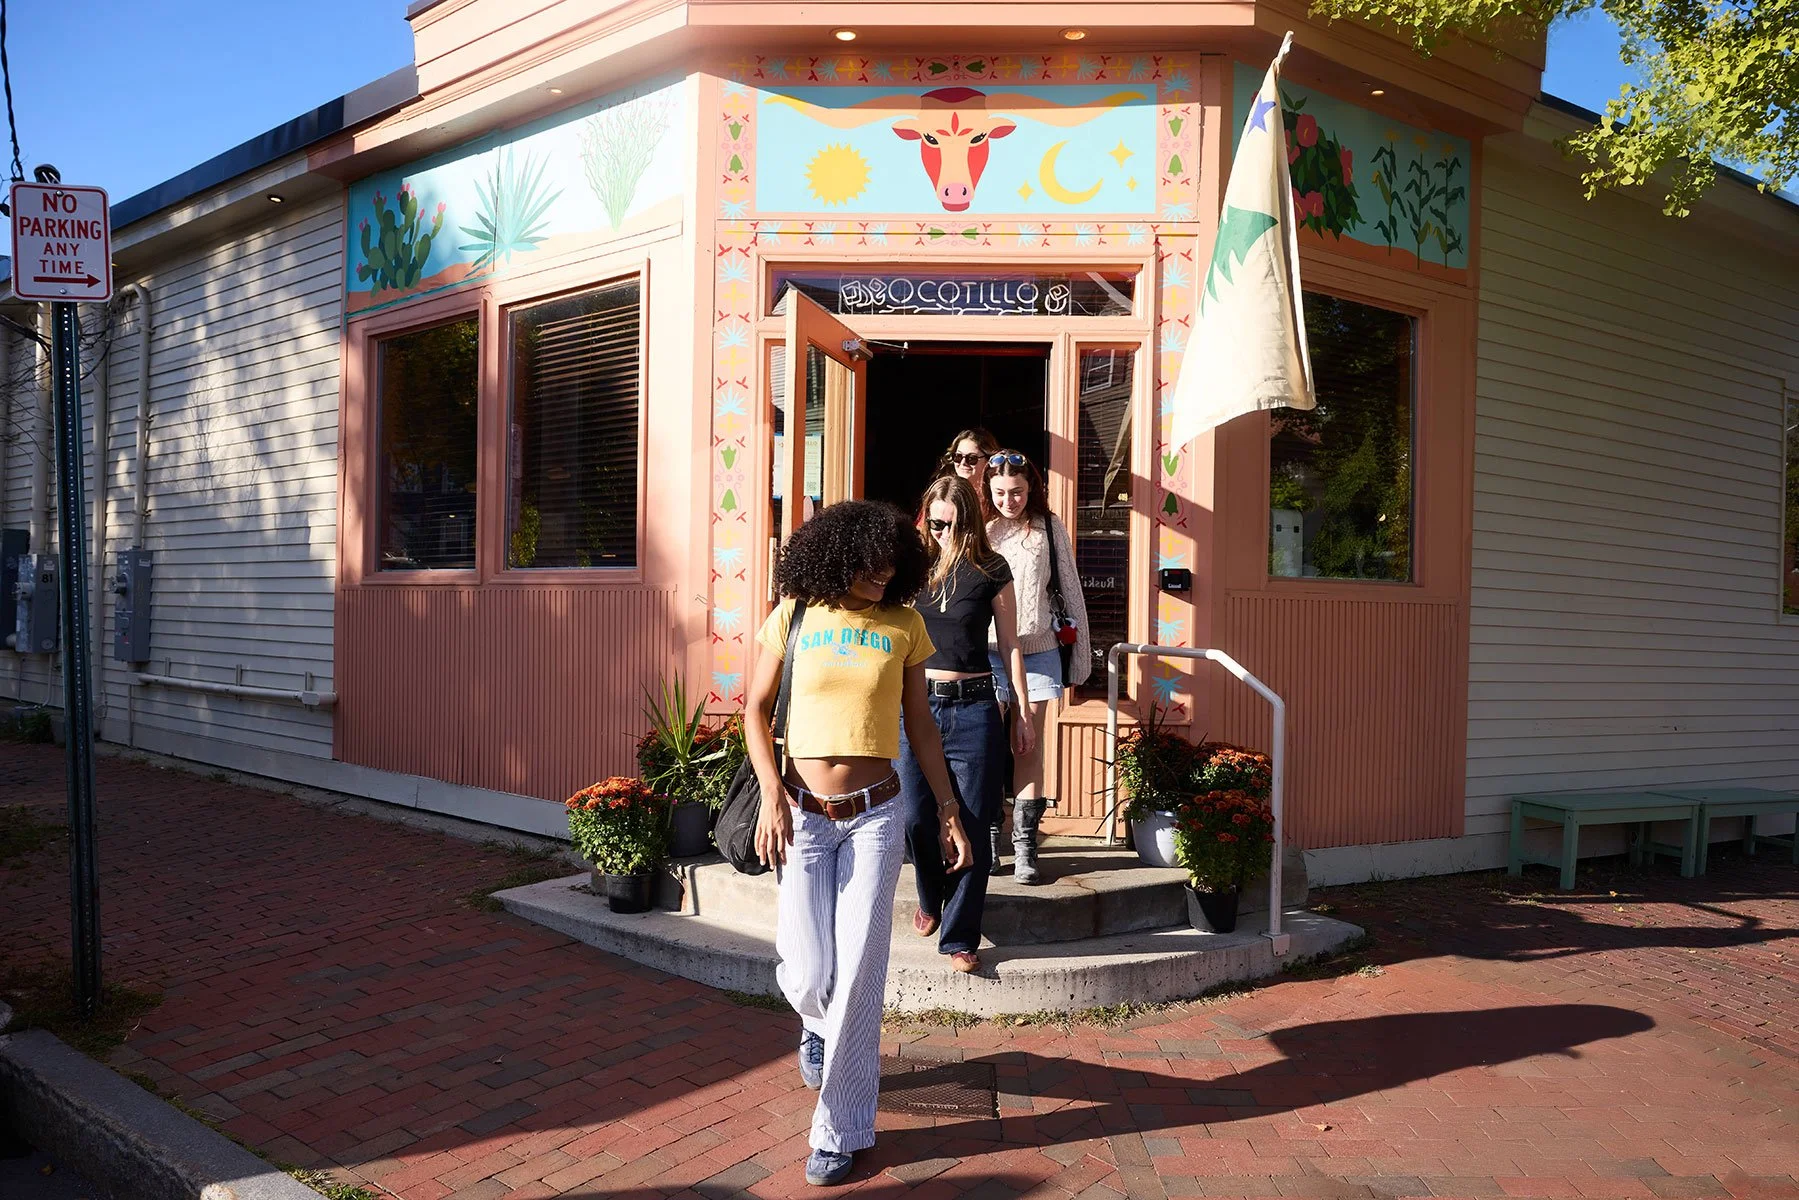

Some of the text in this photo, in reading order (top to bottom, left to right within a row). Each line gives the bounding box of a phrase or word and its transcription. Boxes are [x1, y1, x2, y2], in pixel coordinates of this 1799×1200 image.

[42, 193, 77, 213] NO
[19, 216, 101, 240] PARKING
[43, 242, 80, 256] ANY
[39, 260, 85, 275] TIME
[888, 278, 1039, 304] OCOTILLO
[801, 627, 892, 654] SAN DIEGO
